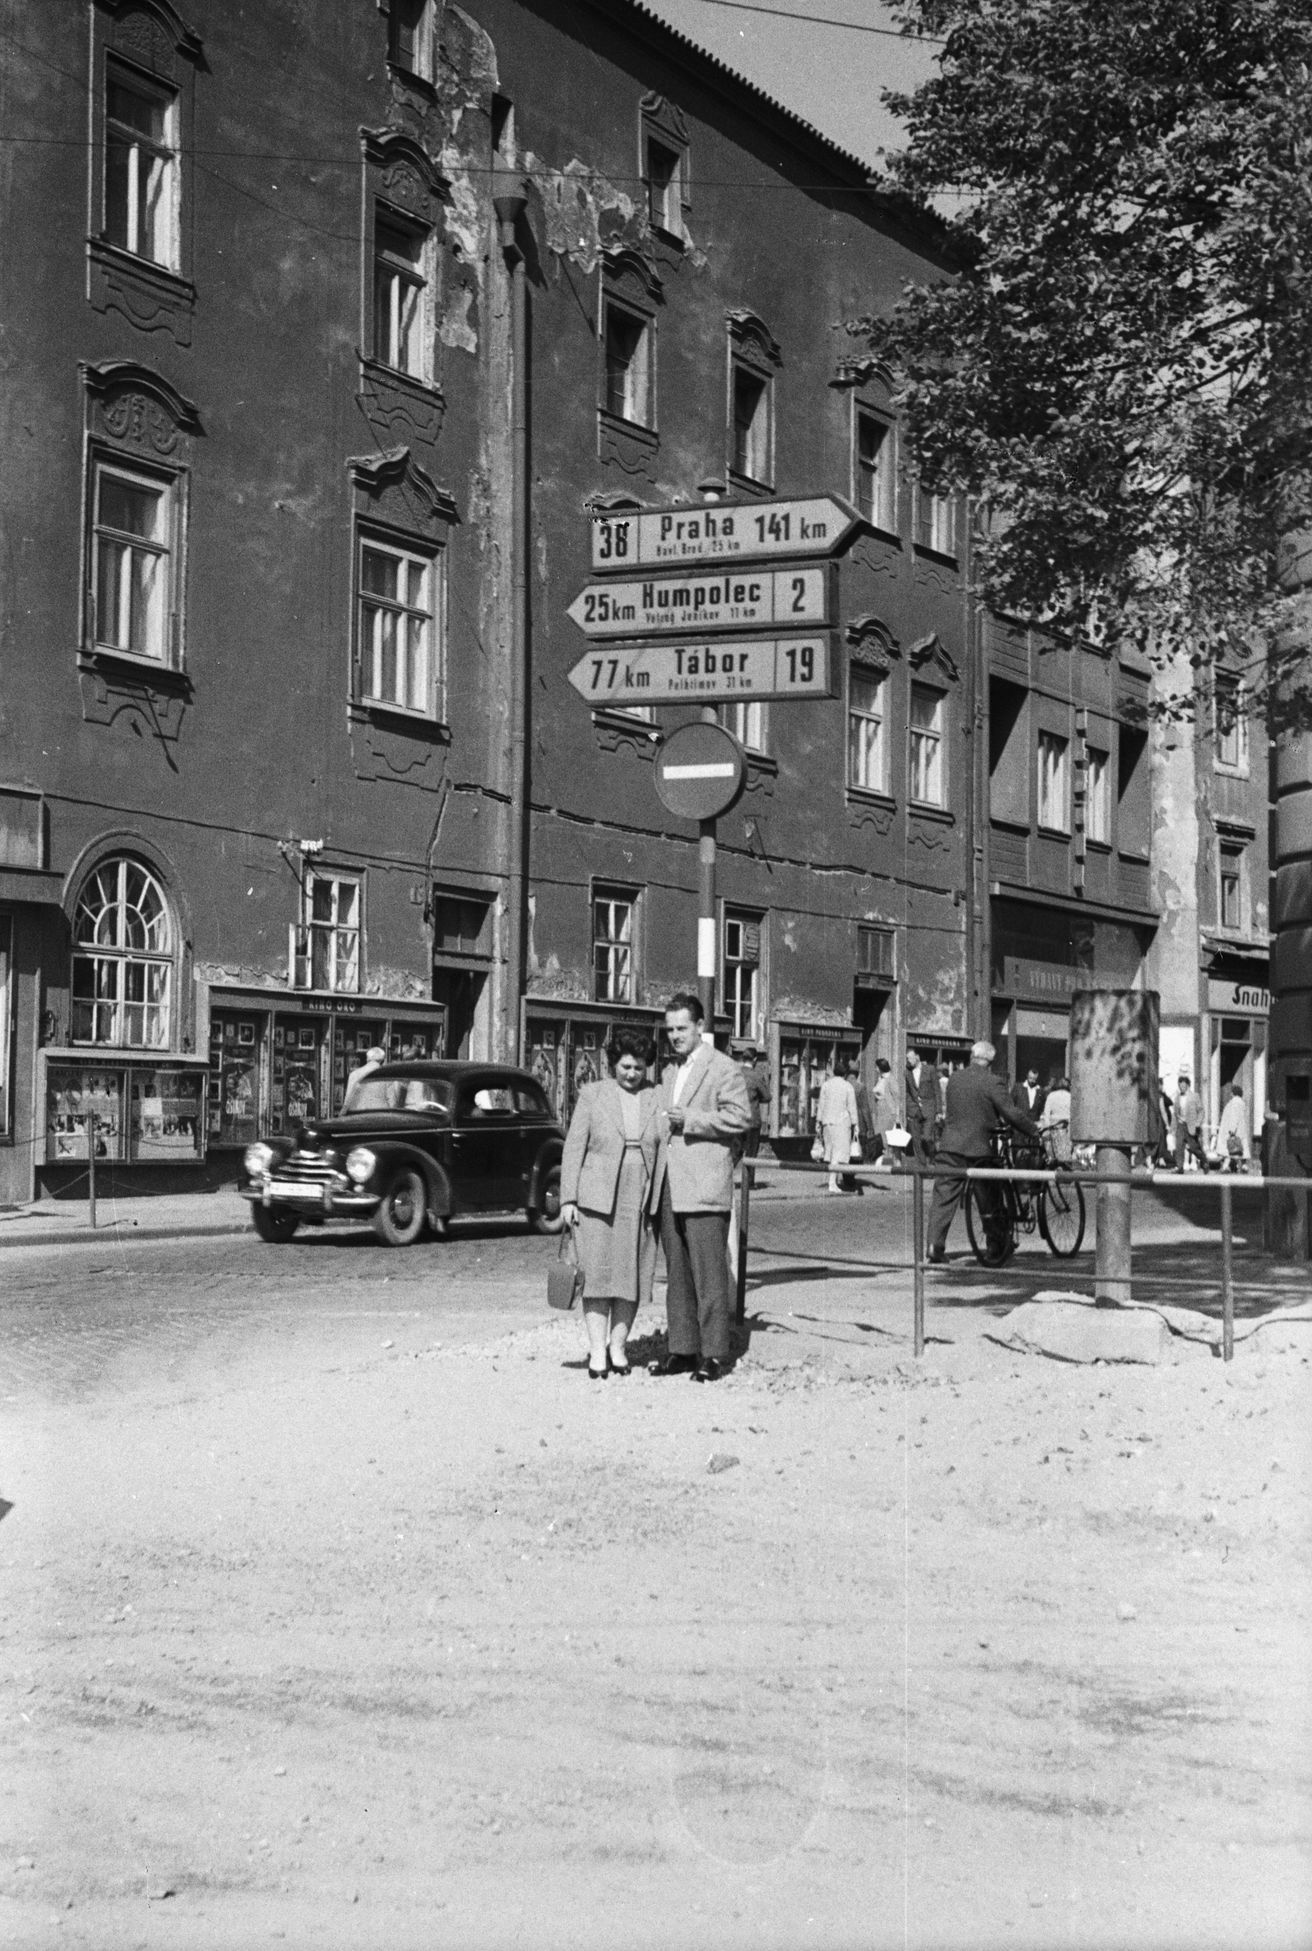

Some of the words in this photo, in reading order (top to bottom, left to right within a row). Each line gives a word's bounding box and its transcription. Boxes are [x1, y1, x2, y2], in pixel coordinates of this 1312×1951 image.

[600, 524, 628, 558] 38
[661, 512, 734, 541] Praha
[755, 512, 790, 542] 141
[801, 517, 827, 539] km
[642, 578, 761, 611] Humpolec
[792, 578, 805, 612] 2
[591, 659, 619, 689] 77
[625, 665, 650, 688] km
[674, 648, 749, 675] Tábor
[786, 646, 814, 682] 19
[1232, 985, 1269, 1008] Snah
